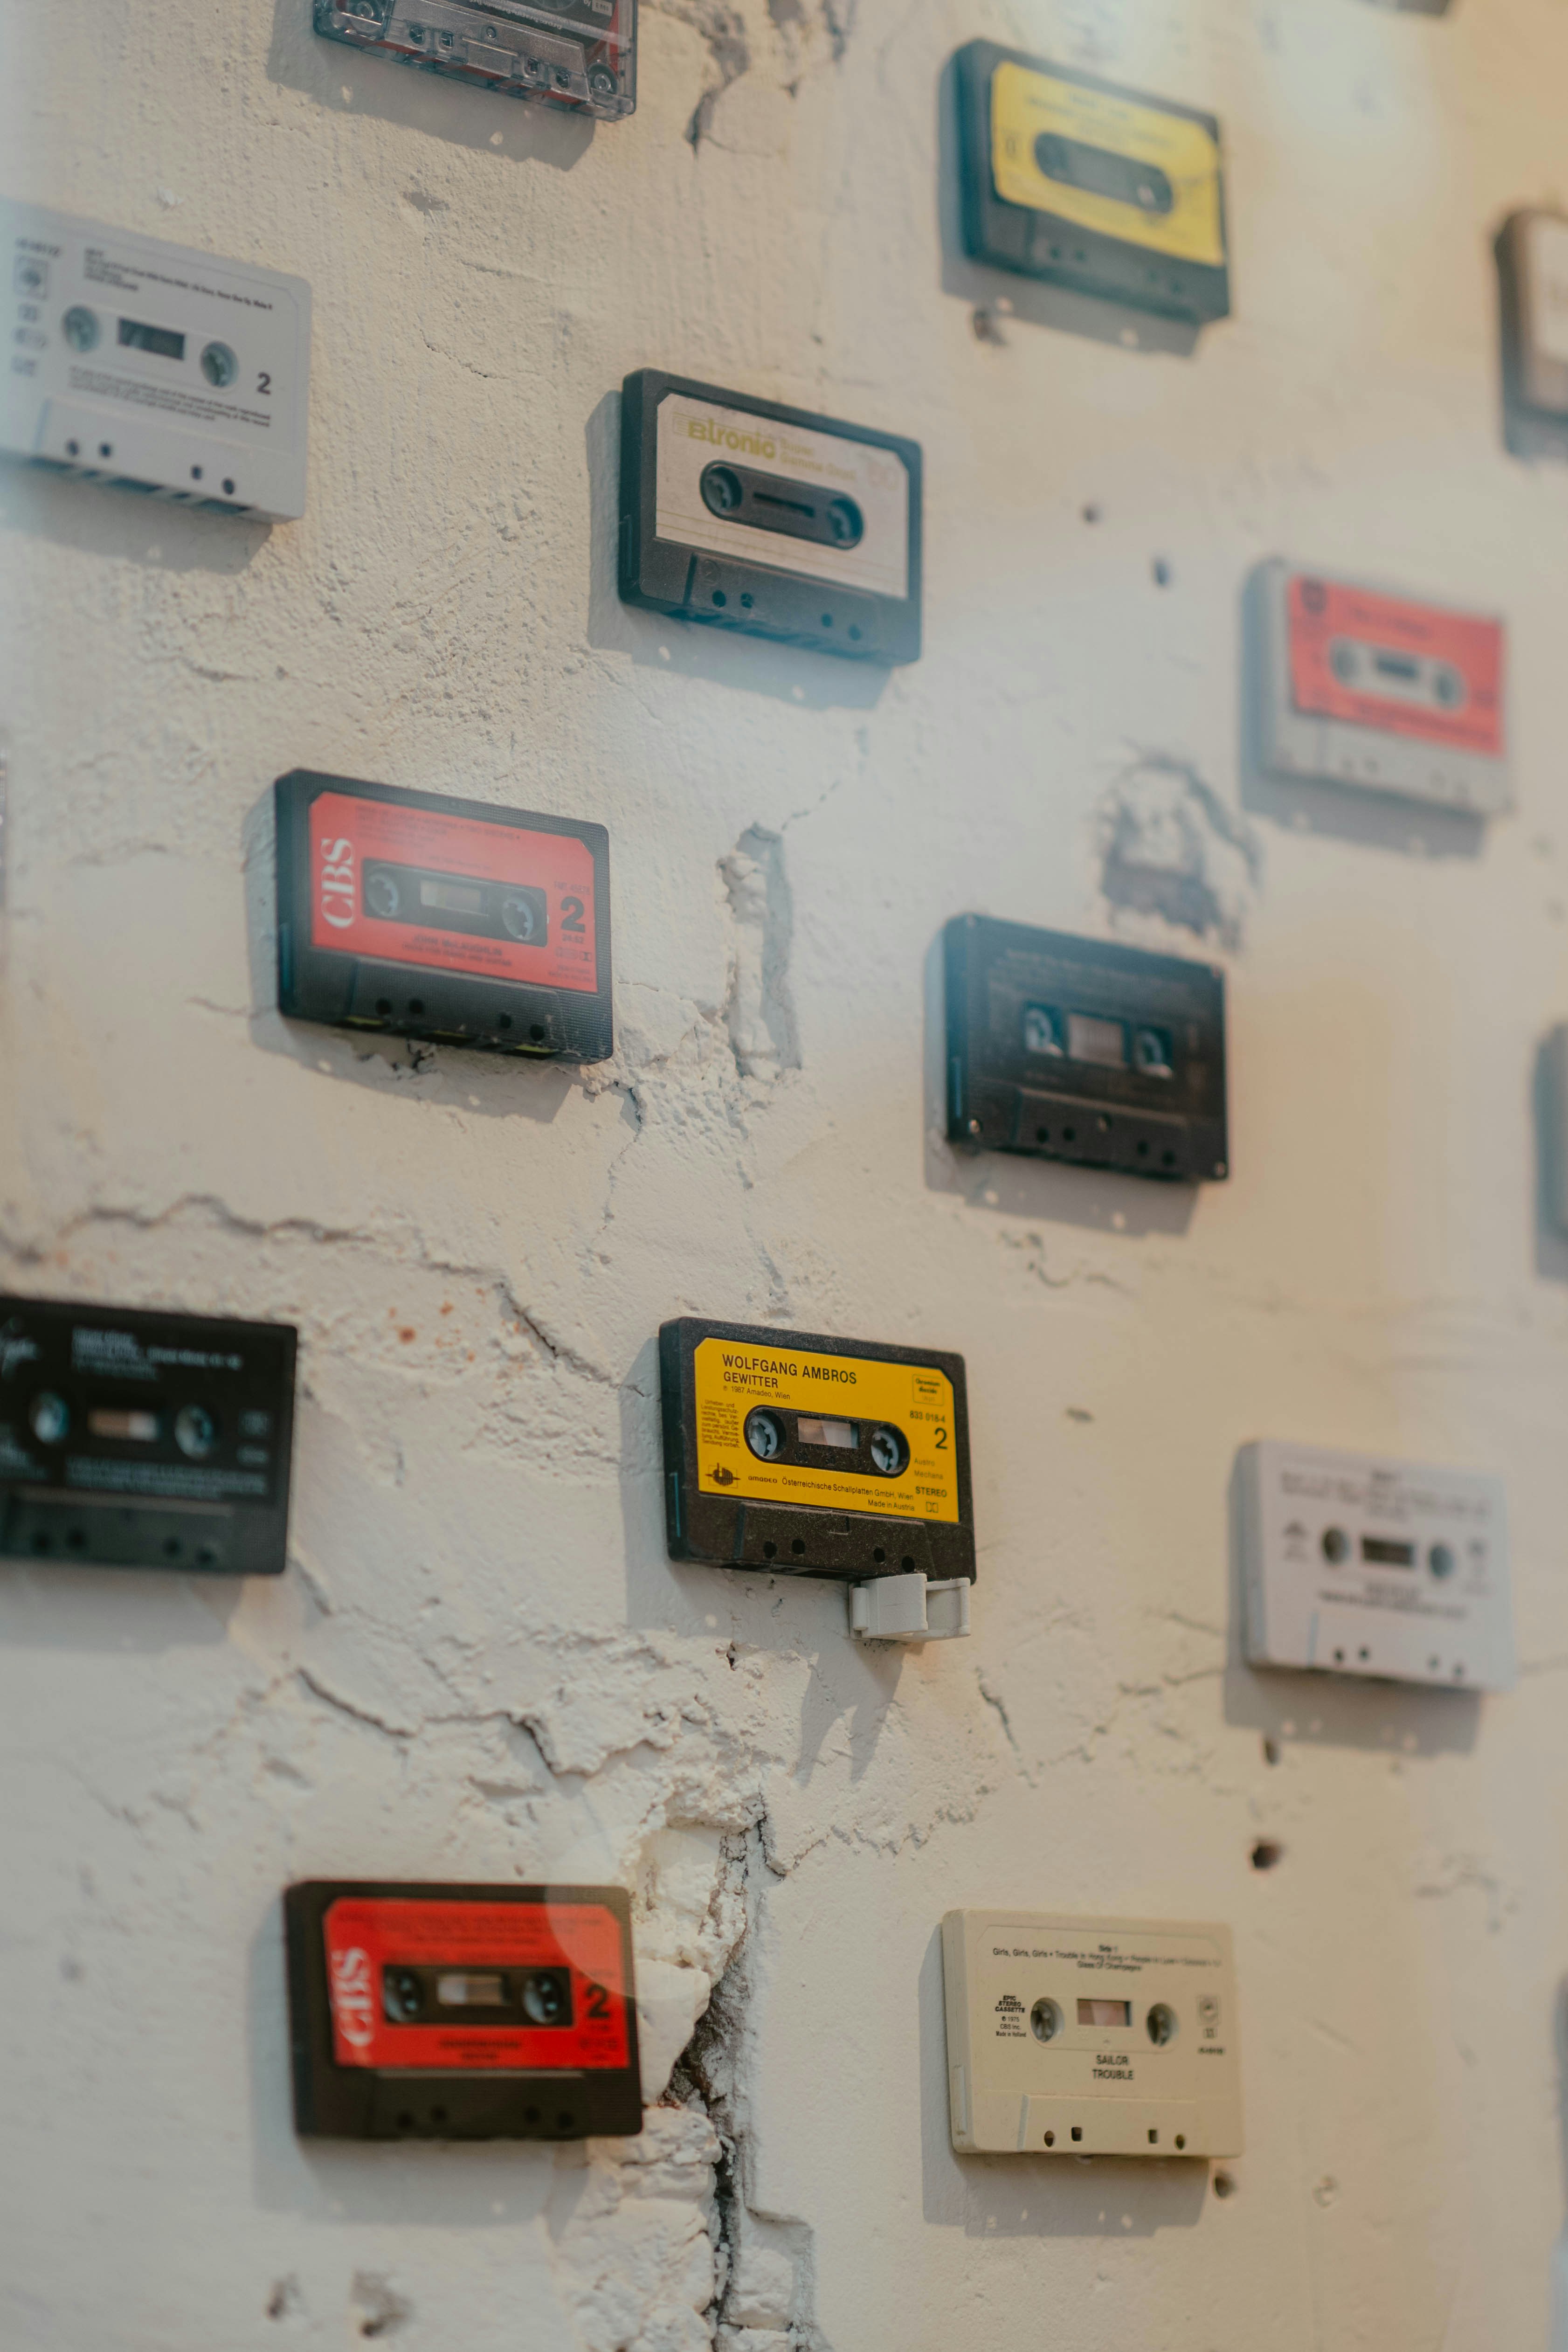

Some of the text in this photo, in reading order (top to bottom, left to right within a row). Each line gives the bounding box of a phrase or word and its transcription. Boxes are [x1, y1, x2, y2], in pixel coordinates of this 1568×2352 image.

[257, 372, 271, 395] 2
[321, 838, 354, 928] CBS
[561, 896, 586, 933] 2
[722, 1354, 857, 1384] WOLFGANG AMBROS
[724, 1371, 778, 1389] GEWITTER
[746, 1388, 773, 1398] Amadeo,
[774, 1391, 790, 1400] Wien
[910, 1411, 946, 1423] 833 018-4
[934, 1427, 948, 1450] 2
[914, 1458, 935, 1467] Austro
[914, 1470, 944, 1480] Mechana
[782, 1476, 832, 1491] Österreichische
[833, 1484, 873, 1496] Schallplatten
[874, 1489, 896, 1500] GmbH,
[898, 1492, 913, 1501] Wien
[915, 1486, 947, 1498] STEREO
[868, 1499, 885, 1508] Made
[893, 1502, 915, 1511] Austria
[993, 1947, 1011, 1957] Girls,
[1013, 1949, 1031, 1958] Girls,
[585, 1984, 610, 2019] 2
[1096, 2055, 1129, 2066] SAILOR
[1092, 2069, 1134, 2080] TROUBLE
